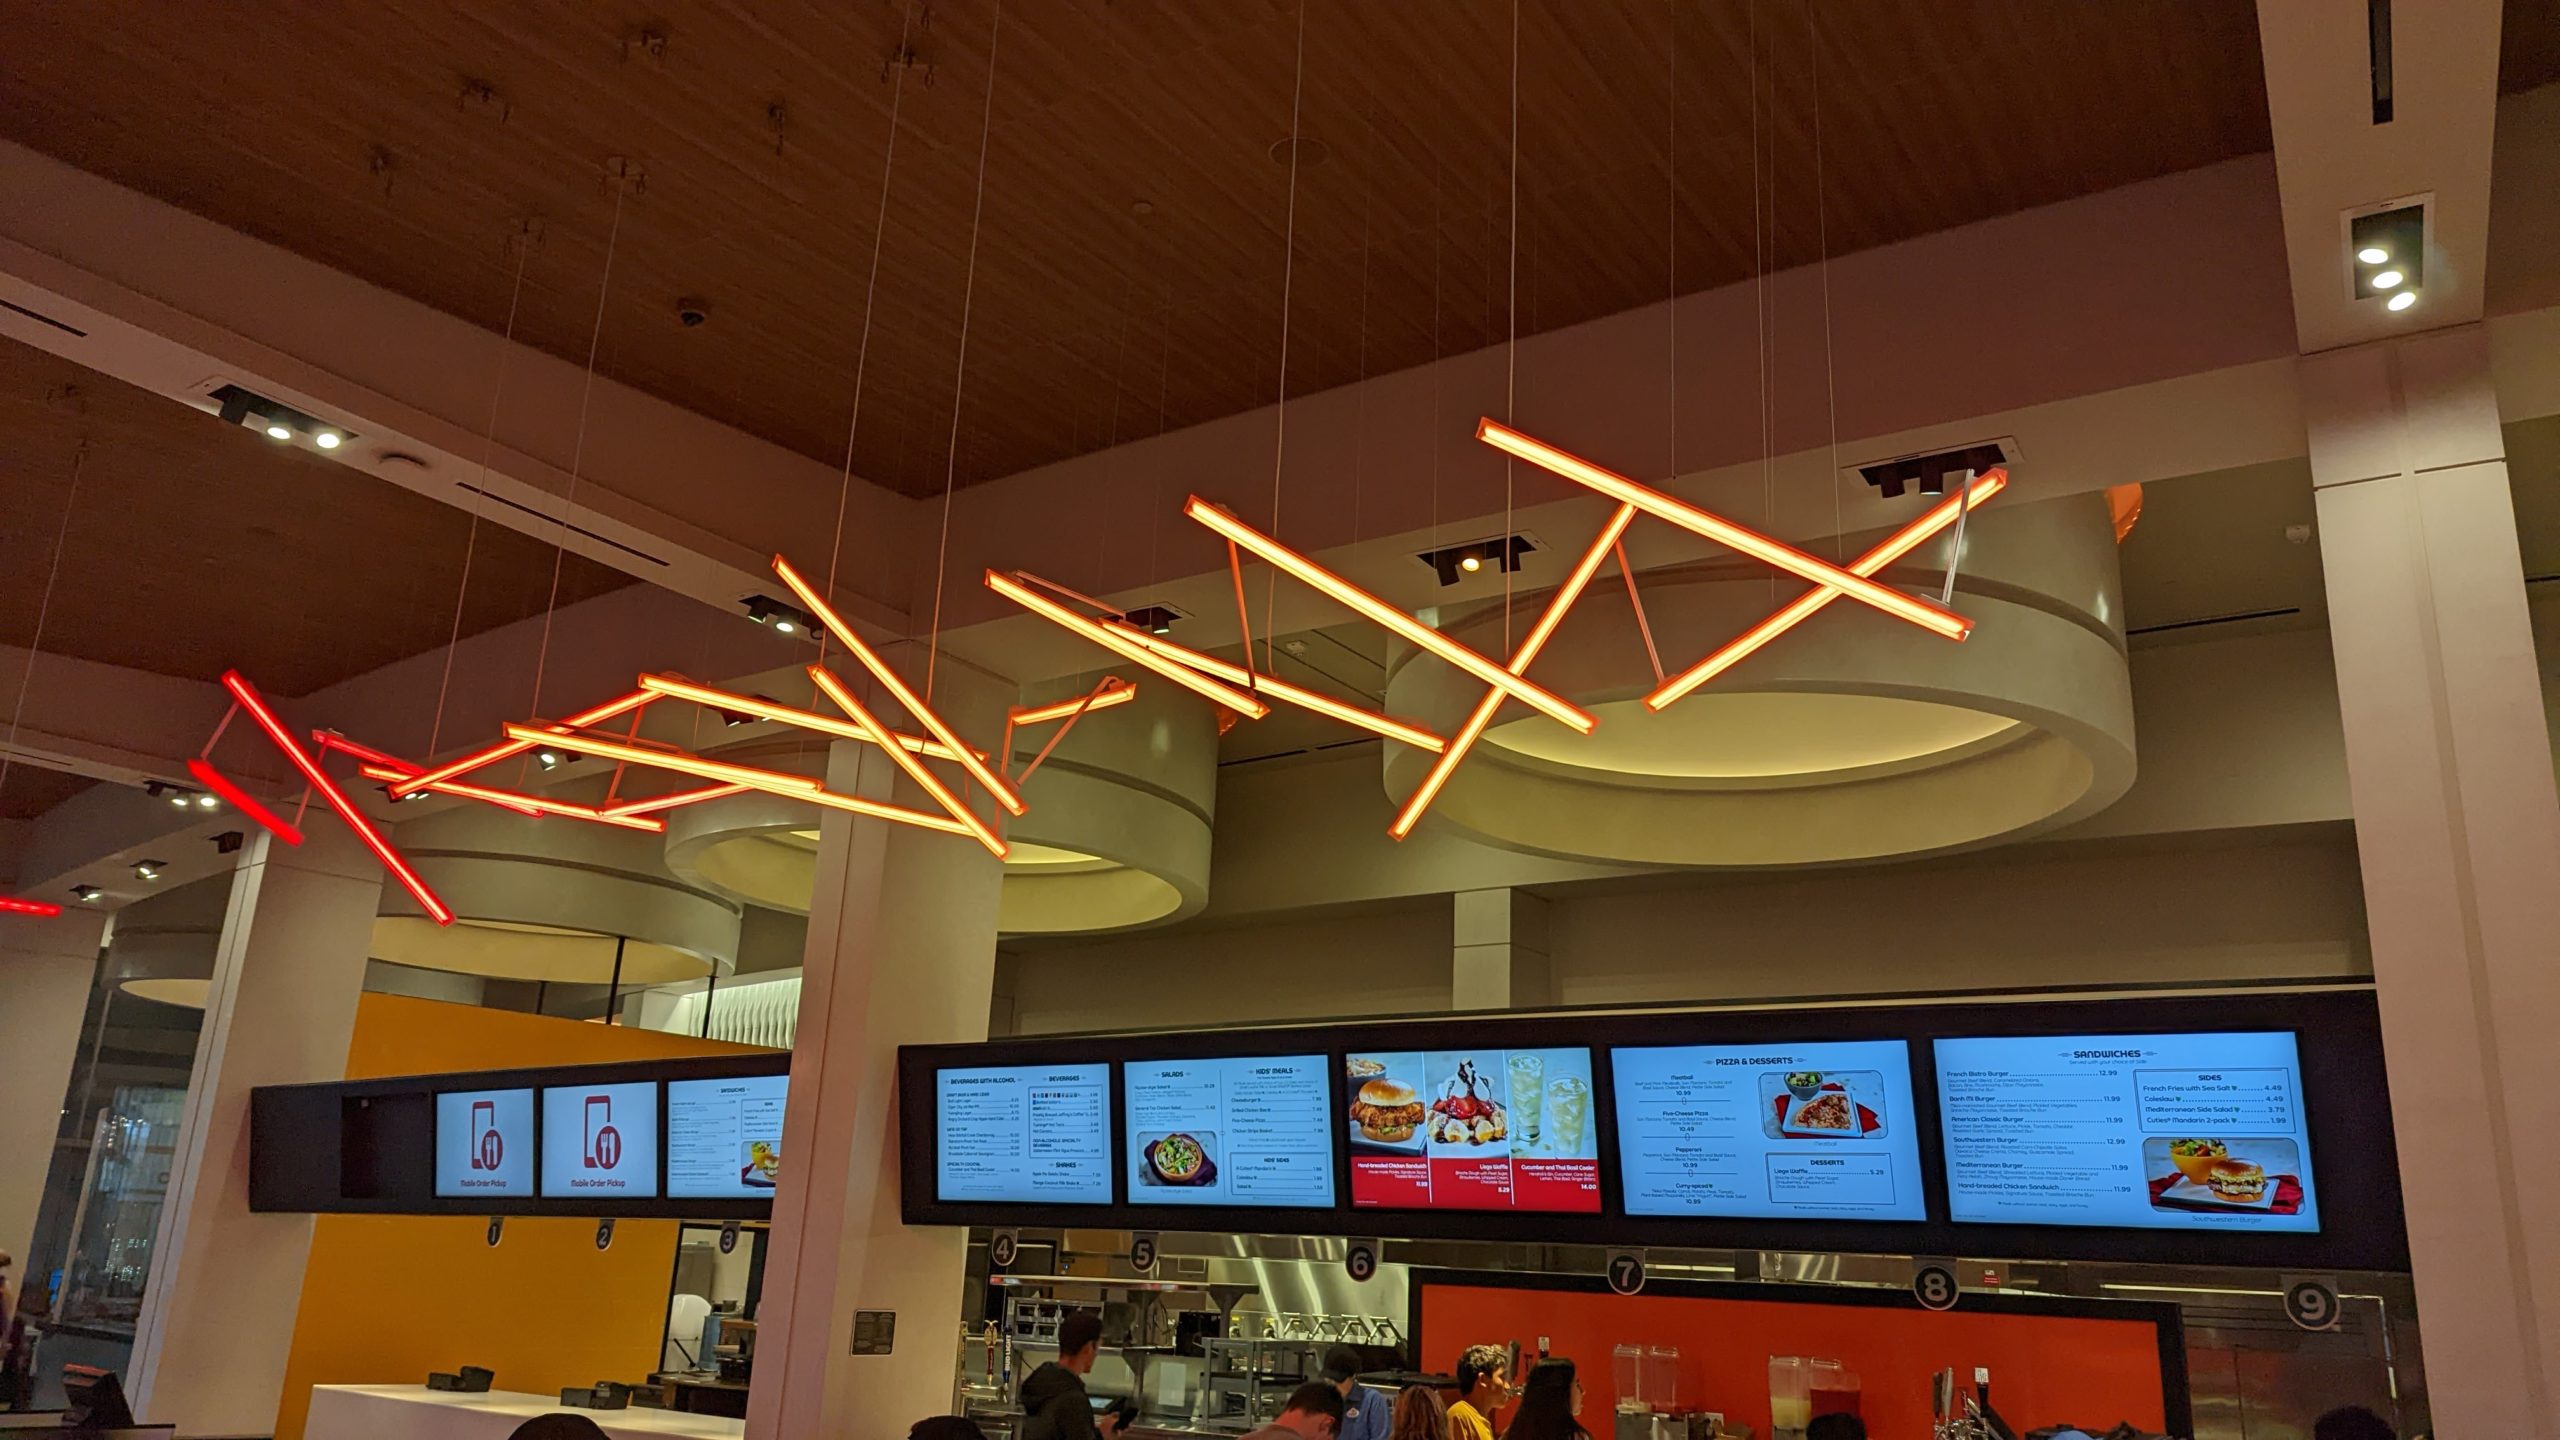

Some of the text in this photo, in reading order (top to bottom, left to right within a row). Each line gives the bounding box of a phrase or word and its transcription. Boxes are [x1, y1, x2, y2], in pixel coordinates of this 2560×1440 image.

[2073, 1050, 2141, 1058] SANDWICHES
[491, 1179, 507, 1188] Pickup
[590, 1179, 606, 1187] Order
[607, 1179, 625, 1188] Pickup
[2114, 1185, 2131, 1193] 11.99
[2192, 1215, 2239, 1223] Southwestern
[491, 1226, 497, 1241] 1
[598, 1228, 607, 1246] 2
[723, 1231, 733, 1250] 3
[995, 1239, 1010, 1259] 4
[1135, 1243, 1150, 1265] 5
[1353, 1252, 1369, 1275] 6
[1615, 1261, 1635, 1288] 7
[1923, 1273, 1948, 1302] 8
[2298, 1289, 2326, 1320] 9
